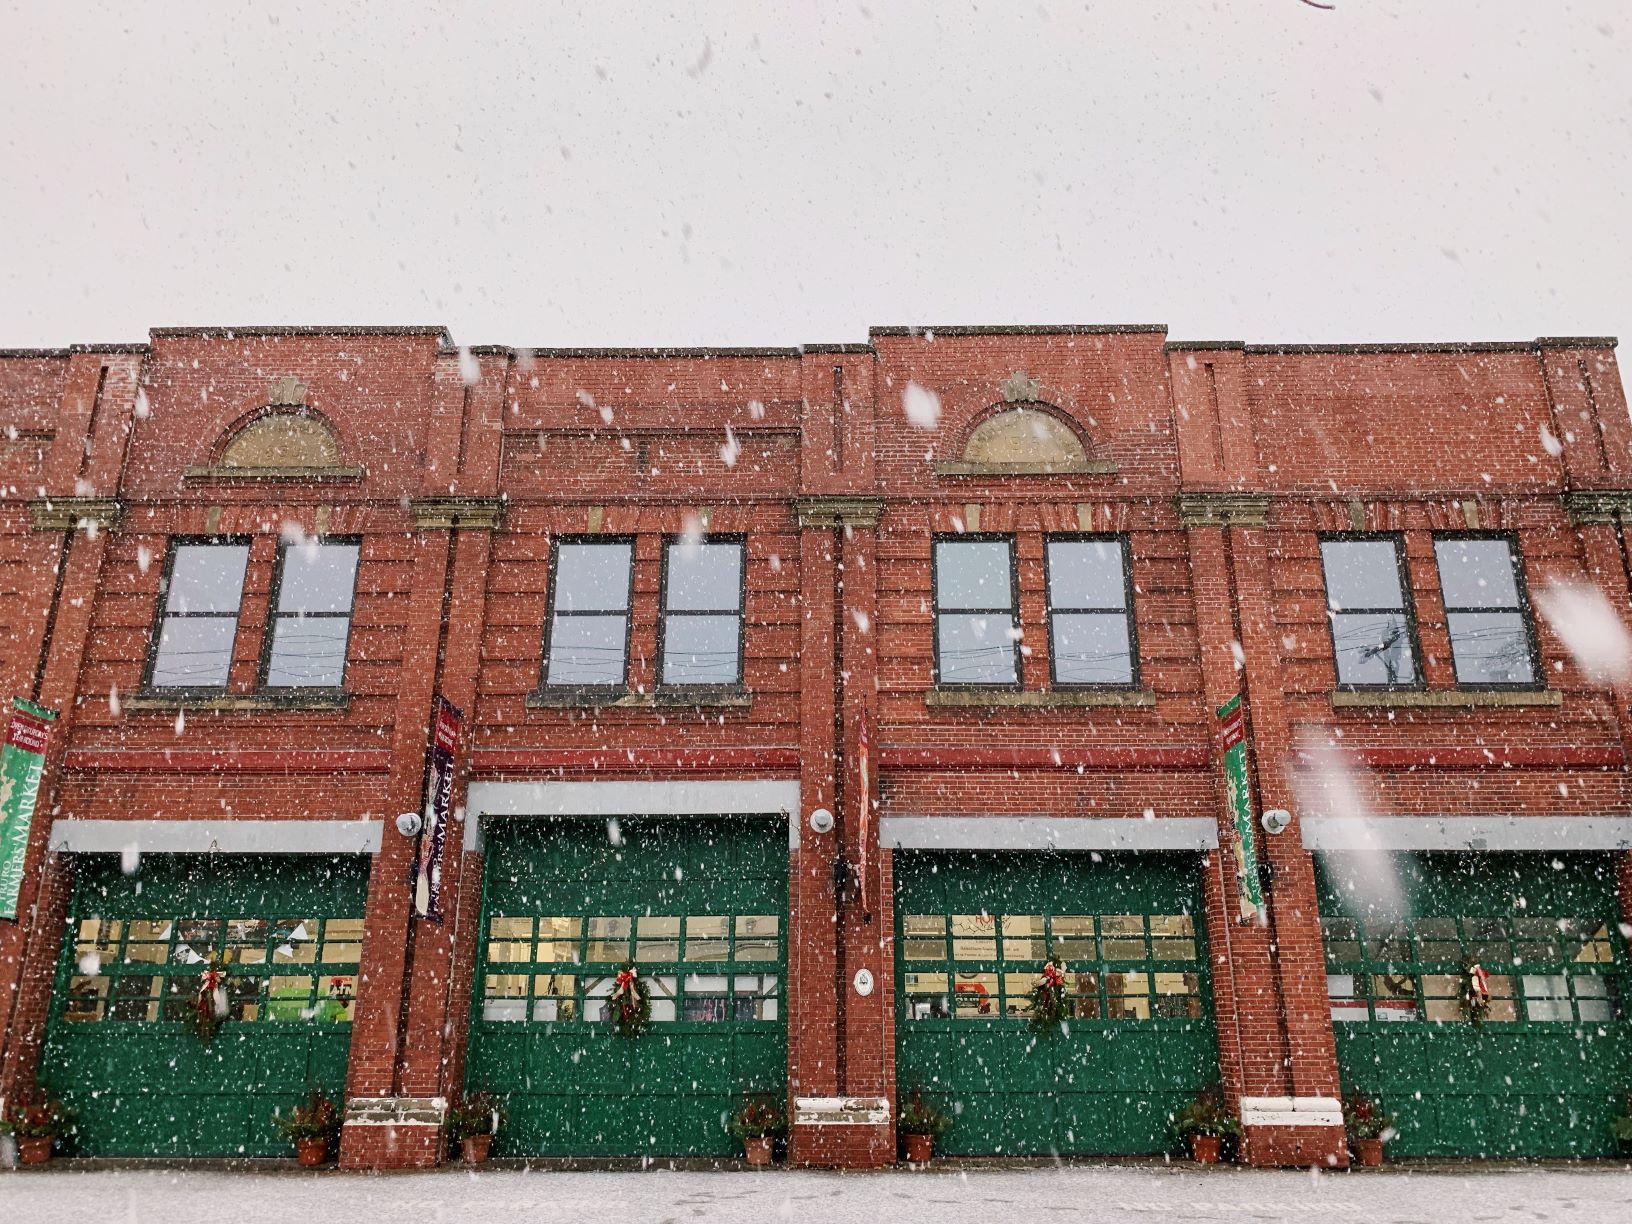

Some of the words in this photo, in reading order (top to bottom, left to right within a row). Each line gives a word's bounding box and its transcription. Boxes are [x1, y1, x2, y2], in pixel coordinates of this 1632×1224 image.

[11, 760, 42, 844] MARKET
[437, 760, 454, 843] MARKET
[1239, 750, 1253, 833] MARKET
